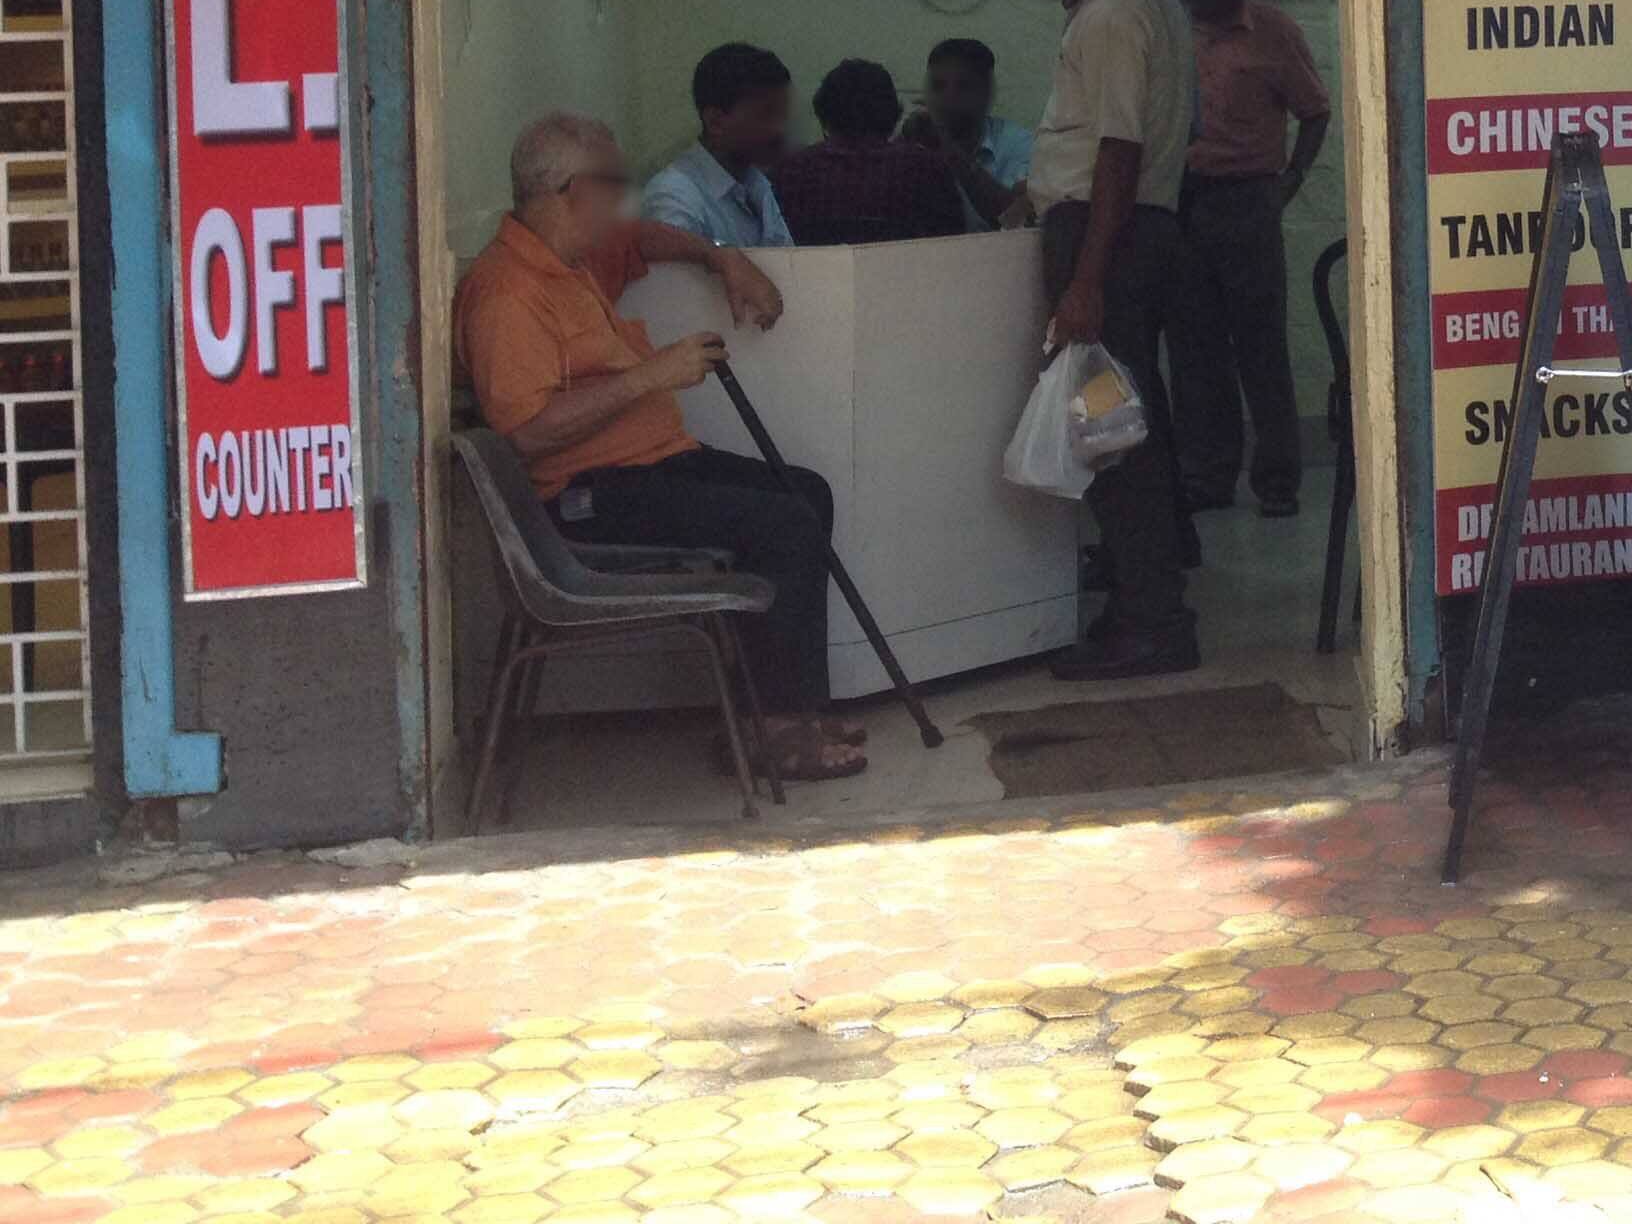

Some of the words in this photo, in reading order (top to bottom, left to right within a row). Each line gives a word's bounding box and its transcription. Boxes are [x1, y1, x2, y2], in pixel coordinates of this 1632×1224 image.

[1467, 3, 1615, 50] INDIAN
[190, 204, 346, 381] OFF
[1445, 308, 1563, 343] BENGI
[196, 424, 354, 521] COUNTER
